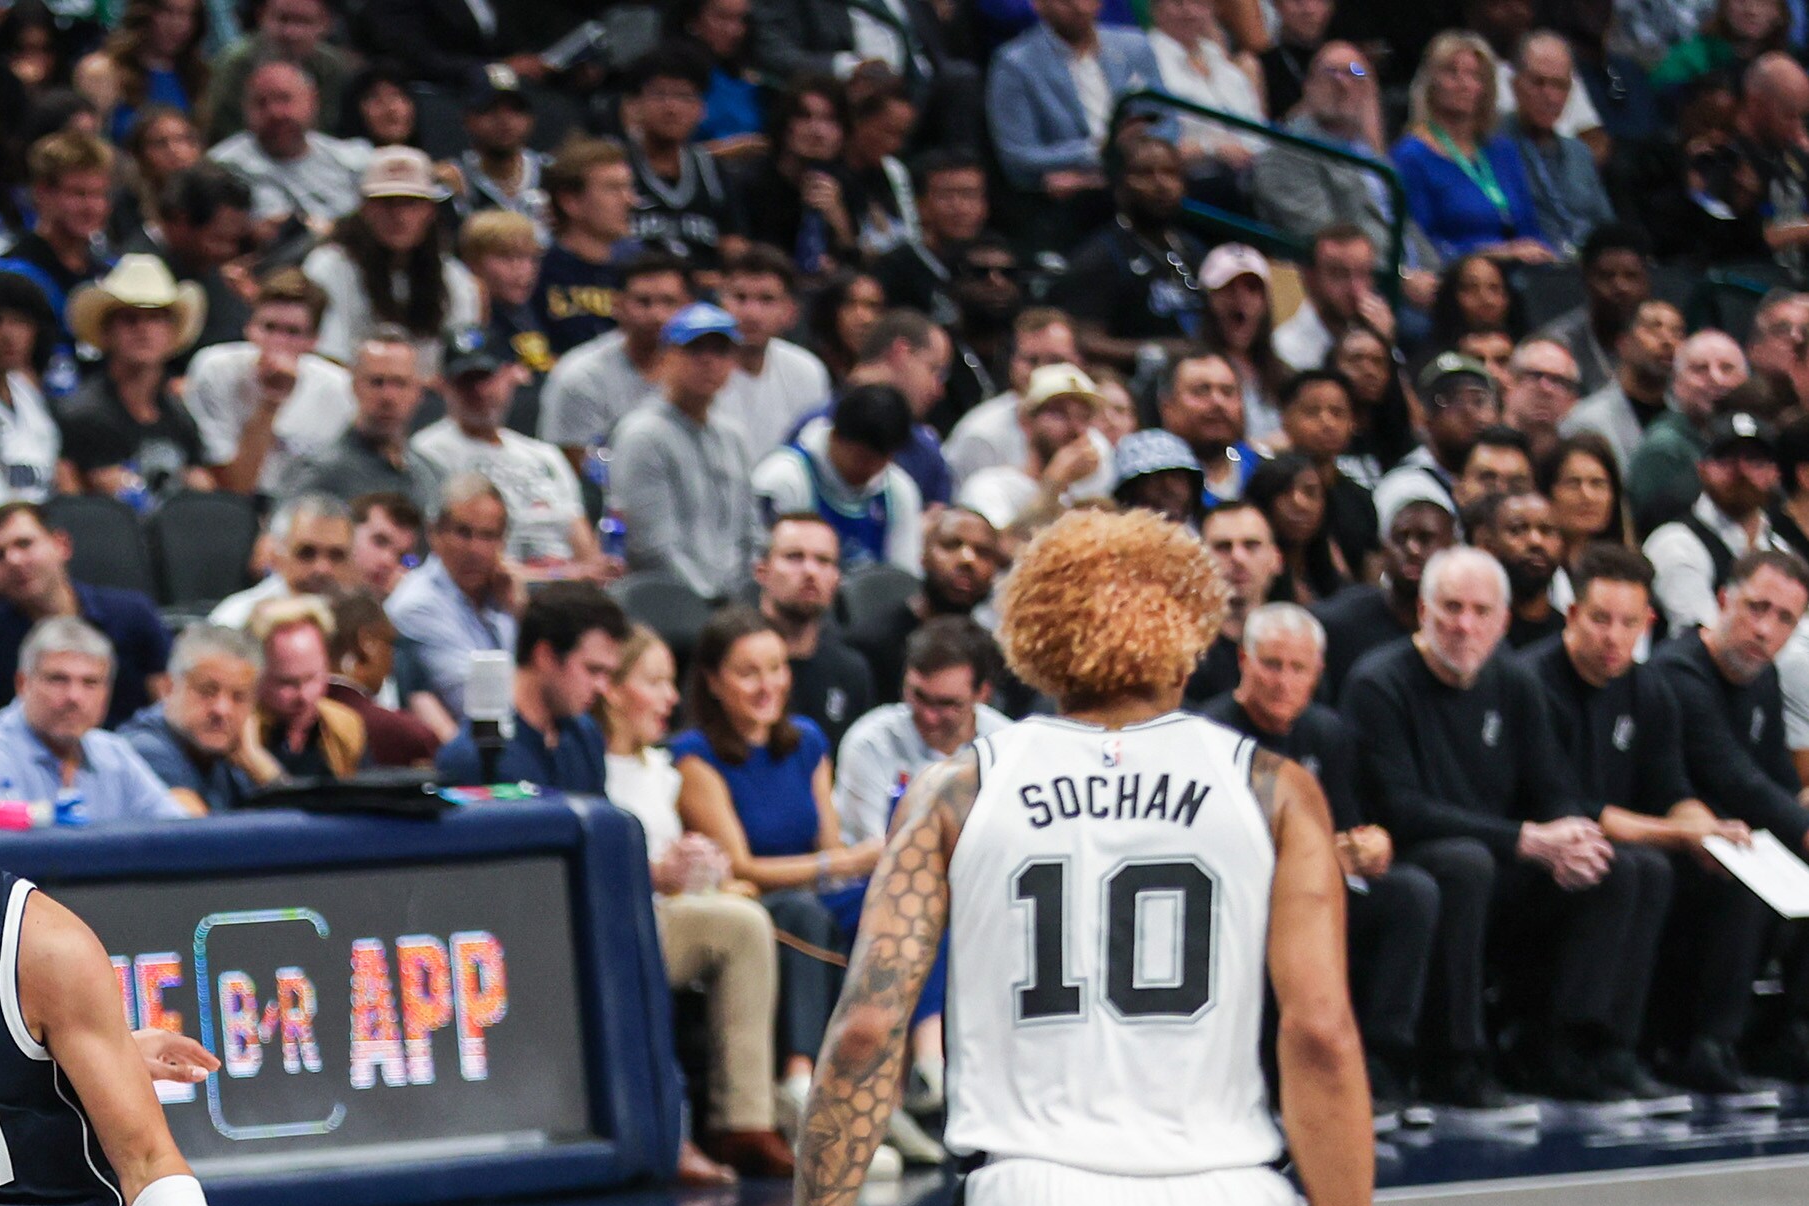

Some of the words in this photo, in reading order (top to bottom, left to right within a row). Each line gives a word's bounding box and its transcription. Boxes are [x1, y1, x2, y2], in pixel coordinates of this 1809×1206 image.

[1019, 773, 1212, 829] SOCHAN
[349, 930, 508, 1089] APP
[1008, 854, 1221, 1026] 10
